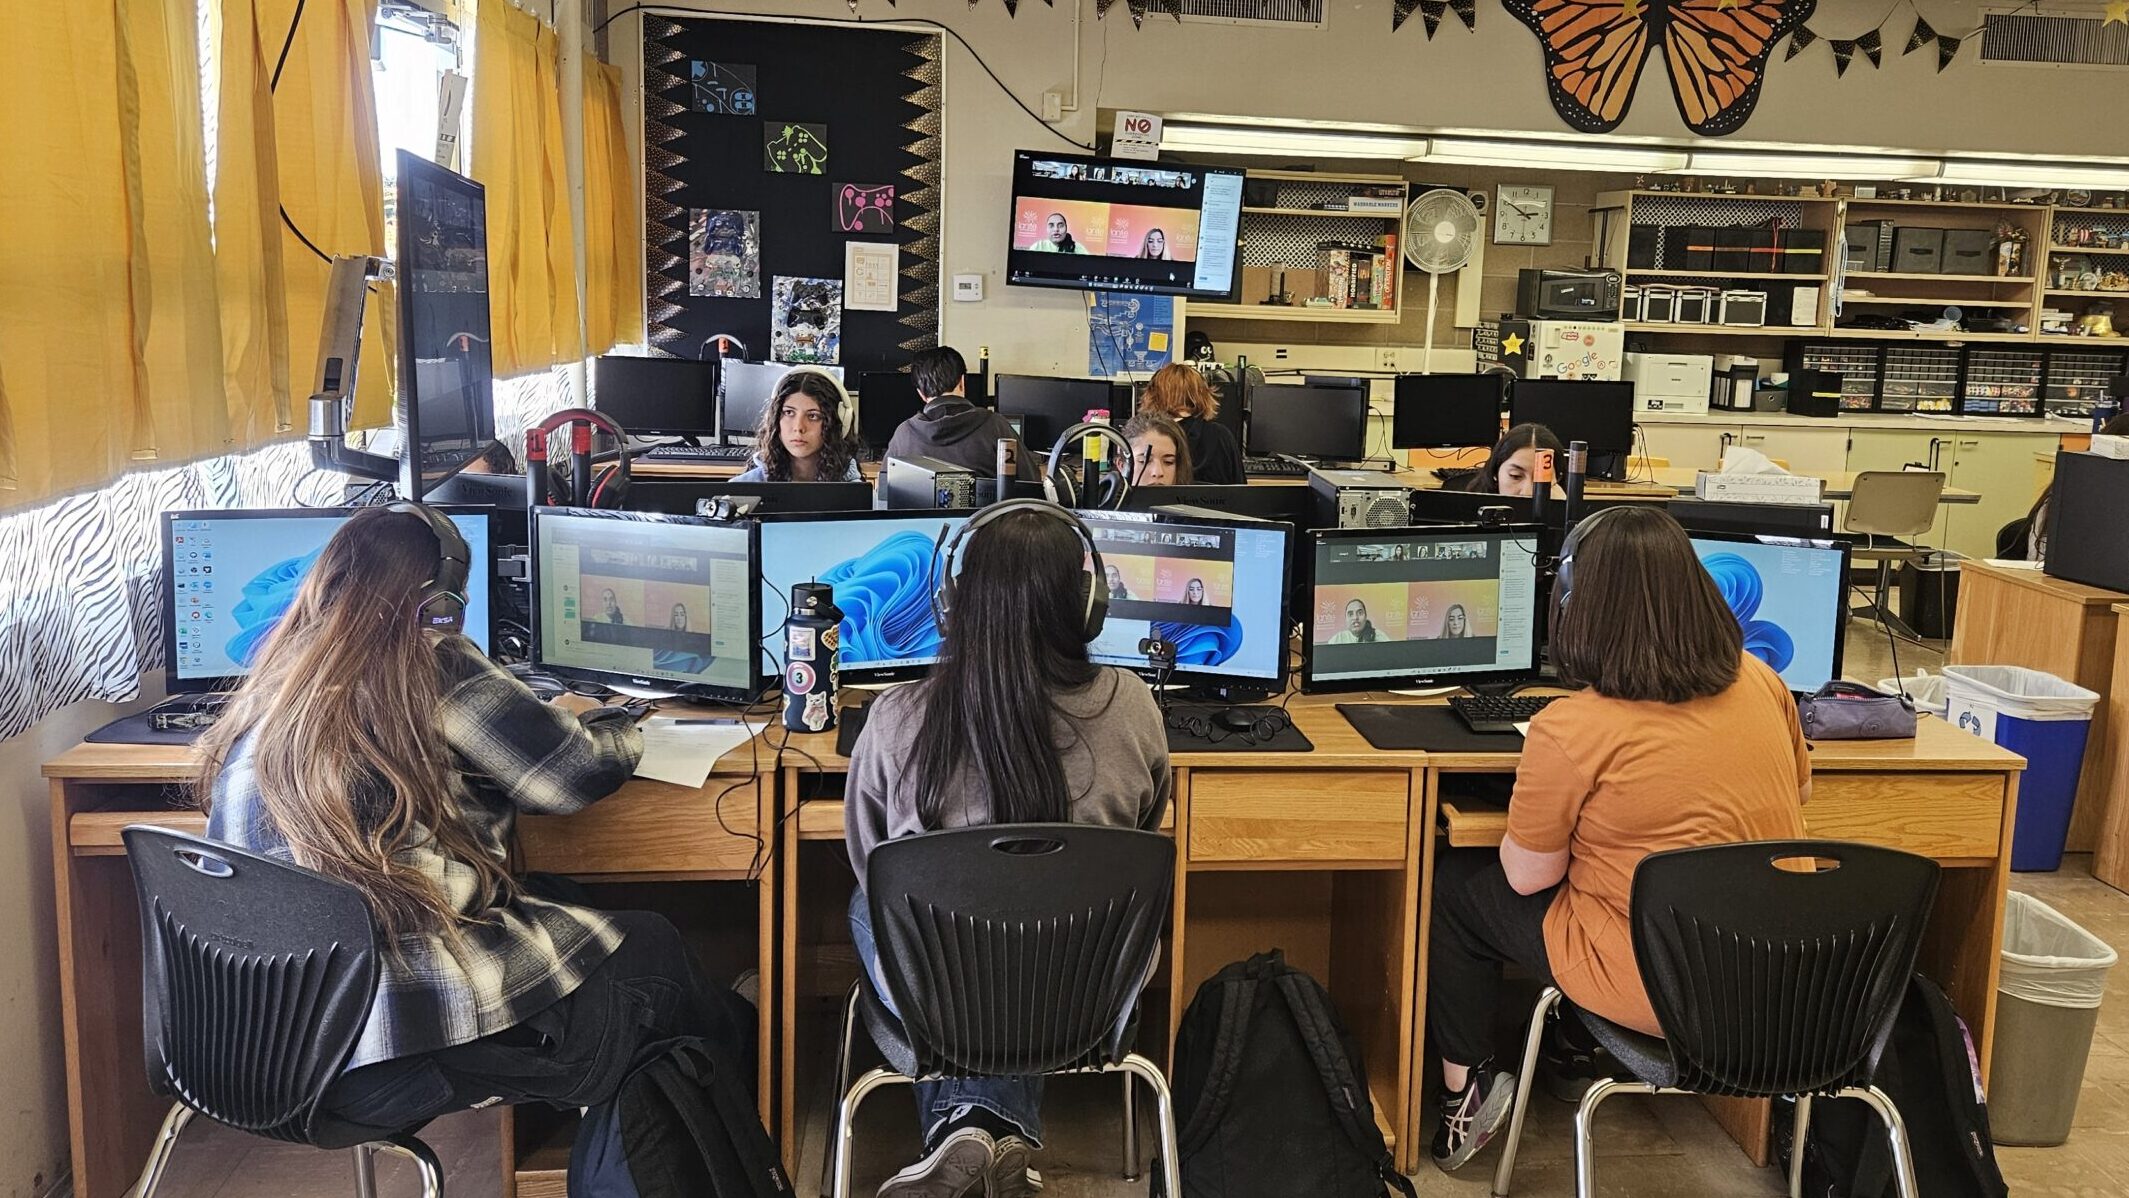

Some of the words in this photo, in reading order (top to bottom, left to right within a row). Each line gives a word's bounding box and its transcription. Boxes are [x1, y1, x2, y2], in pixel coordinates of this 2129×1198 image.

[1350, 263, 1358, 298] HORRIFIED
[1556, 351, 1598, 374] Google
[531, 434, 544, 452] 1
[1005, 448, 1016, 464] 2
[1543, 454, 1552, 470] 3
[796, 672, 803, 684] 3
